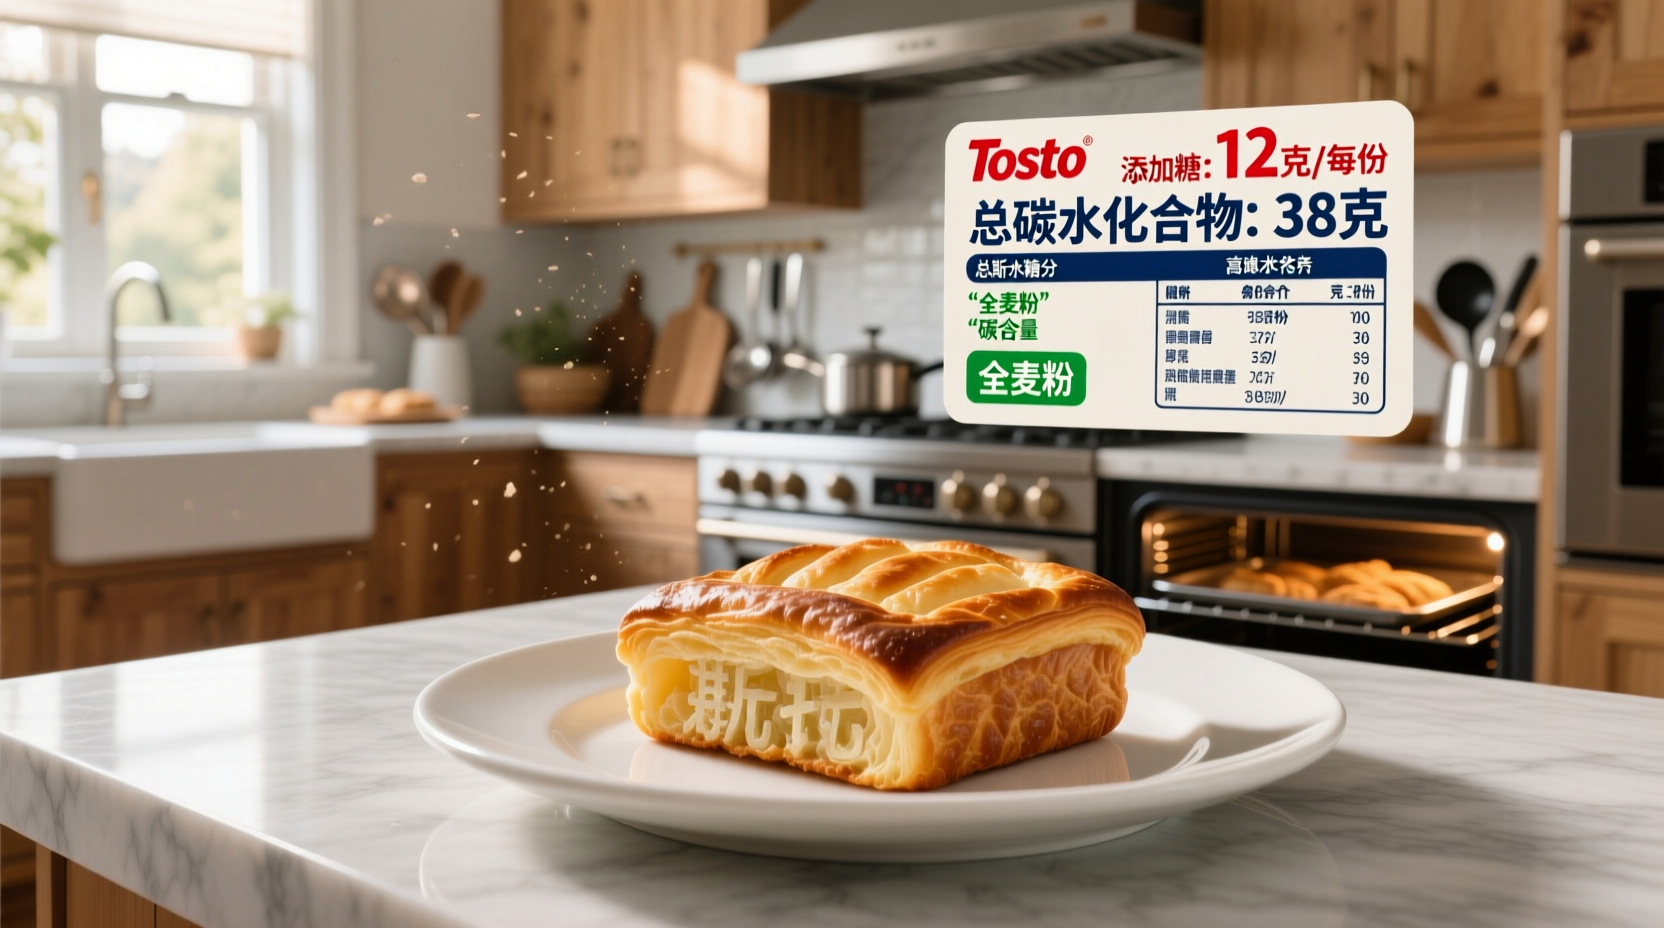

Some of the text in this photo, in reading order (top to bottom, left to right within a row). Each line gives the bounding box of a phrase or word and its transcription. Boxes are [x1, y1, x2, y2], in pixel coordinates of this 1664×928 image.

[968, 138, 1087, 182] Tosto
[979, 360, 1074, 398] 全麦粉
